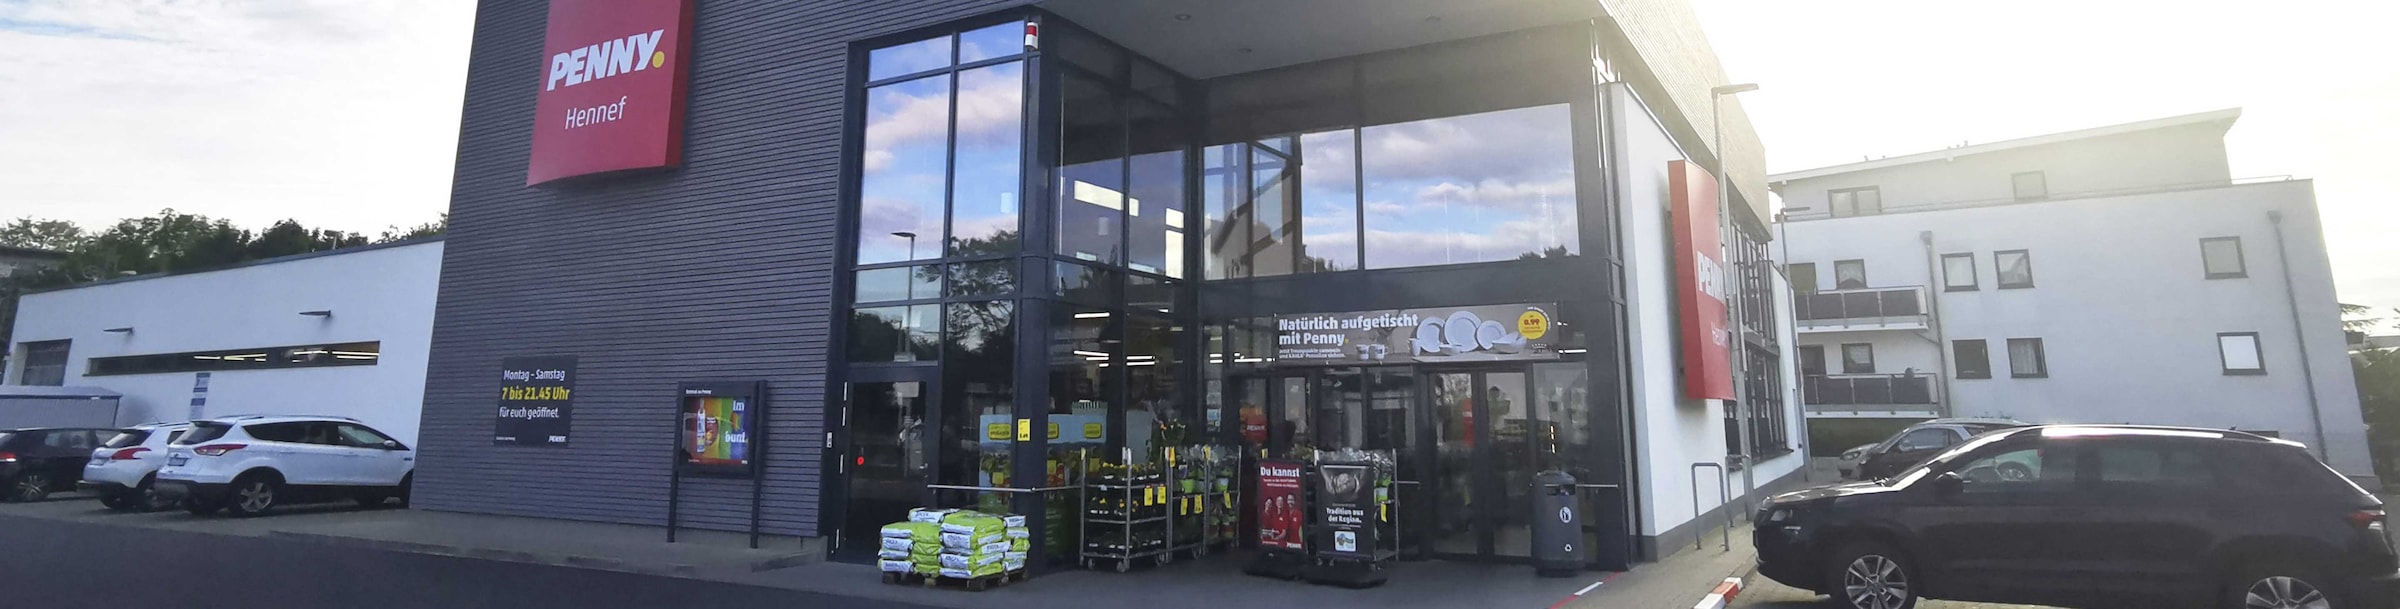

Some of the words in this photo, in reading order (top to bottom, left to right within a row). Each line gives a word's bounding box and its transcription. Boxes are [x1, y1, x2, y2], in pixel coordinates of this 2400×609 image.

[564, 95, 627, 130] Hennef
[1279, 316, 1339, 331] Natürlich
[1341, 313, 1419, 331] aufgetischt
[1279, 331, 1301, 345] mit
[503, 369, 530, 382] Montag
[535, 369, 565, 381] Samstag
[502, 387, 508, 400] 7
[509, 386, 523, 400] bis
[524, 387, 551, 400] 21.45
[552, 387, 571, 400] Uhr
[499, 406, 510, 418] für
[510, 406, 527, 418] euch
[527, 407, 559, 420] geöffnet.
[1260, 466, 1272, 476] Du
[1272, 467, 1300, 477] kannst
[1326, 507, 1352, 516] Tradition
[1328, 514, 1338, 522] der
